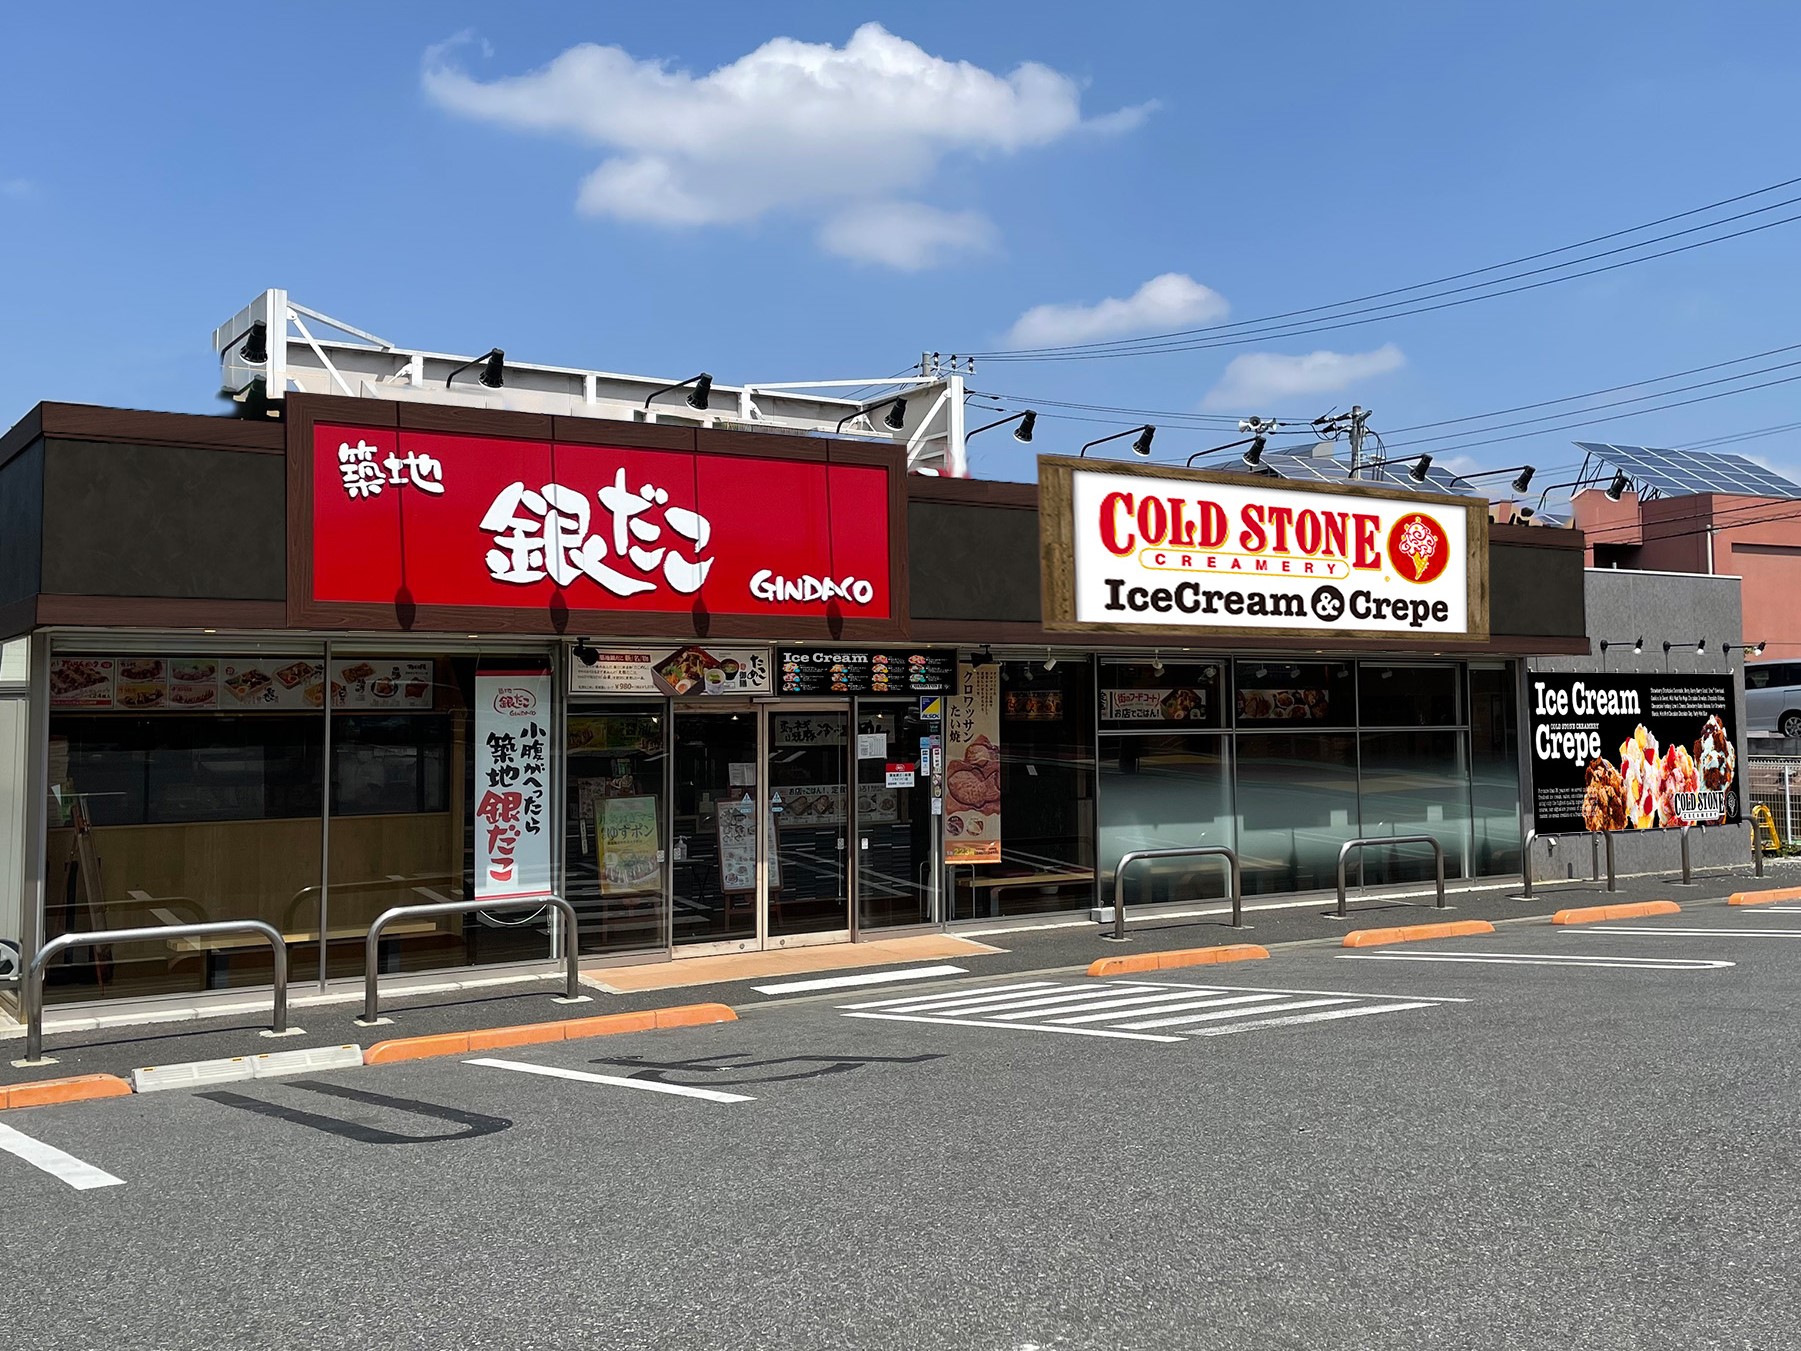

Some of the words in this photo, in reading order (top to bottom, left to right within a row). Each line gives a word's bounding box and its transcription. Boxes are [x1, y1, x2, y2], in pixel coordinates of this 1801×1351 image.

[338, 439, 445, 498] 築地
[479, 466, 714, 597] 銀だこ
[1099, 491, 1239, 557] COLD
[1239, 503, 1382, 571] STONE
[1155, 552, 1337, 575] CREAMERY
[749, 568, 874, 604] GINDACO
[1349, 589, 1449, 628] Crepe
[783, 652, 810, 663] Ice
[812, 652, 869, 664] Cream
[962, 670, 975, 743] クロワッサン
[1535, 682, 1569, 716] Ice
[1572, 681, 1642, 716] Cream
[949, 704, 962, 743] たい焼
[1535, 723, 1602, 768] Crepe
[519, 721, 547, 836] 小腹がへったら
[1674, 793, 1697, 817] COLD
[1697, 791, 1725, 815] STONE
